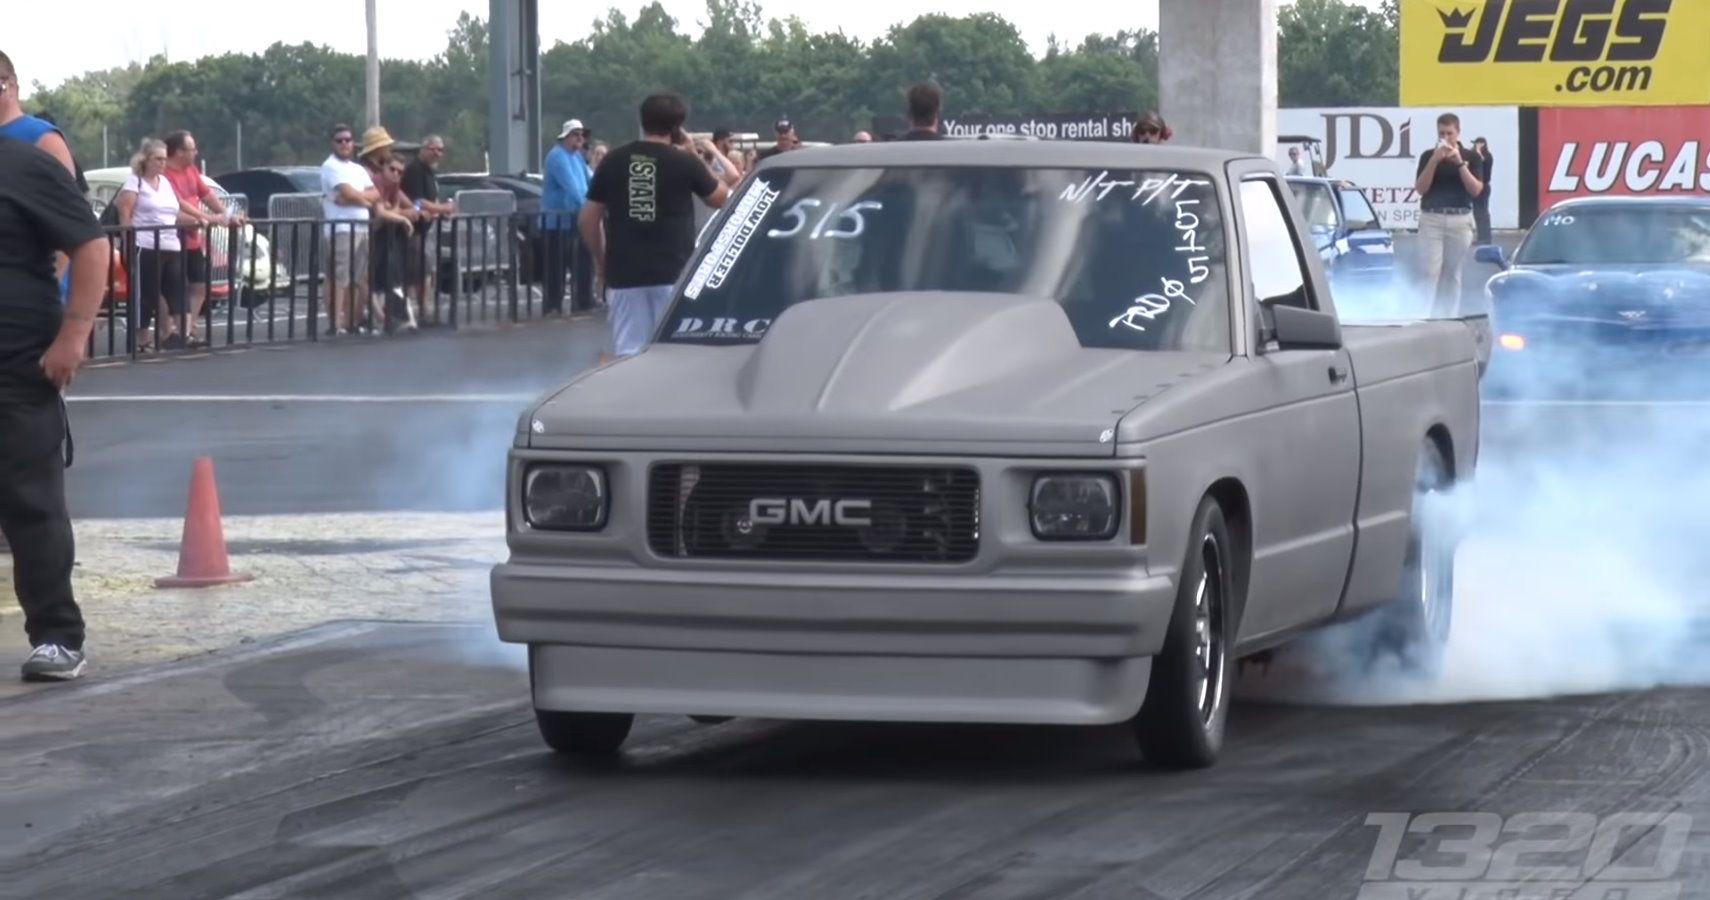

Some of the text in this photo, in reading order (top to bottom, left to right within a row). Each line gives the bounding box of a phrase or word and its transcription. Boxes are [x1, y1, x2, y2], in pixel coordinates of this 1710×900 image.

[1437, 0, 1673, 63] JEGS
[1554, 65, 1653, 92] .com
[943, 117, 1138, 138] Your one stop rental sh
[629, 161, 656, 222] STAFF
[767, 198, 882, 239] 515
[676, 317, 771, 333] DRC
[750, 498, 872, 525] GMC
